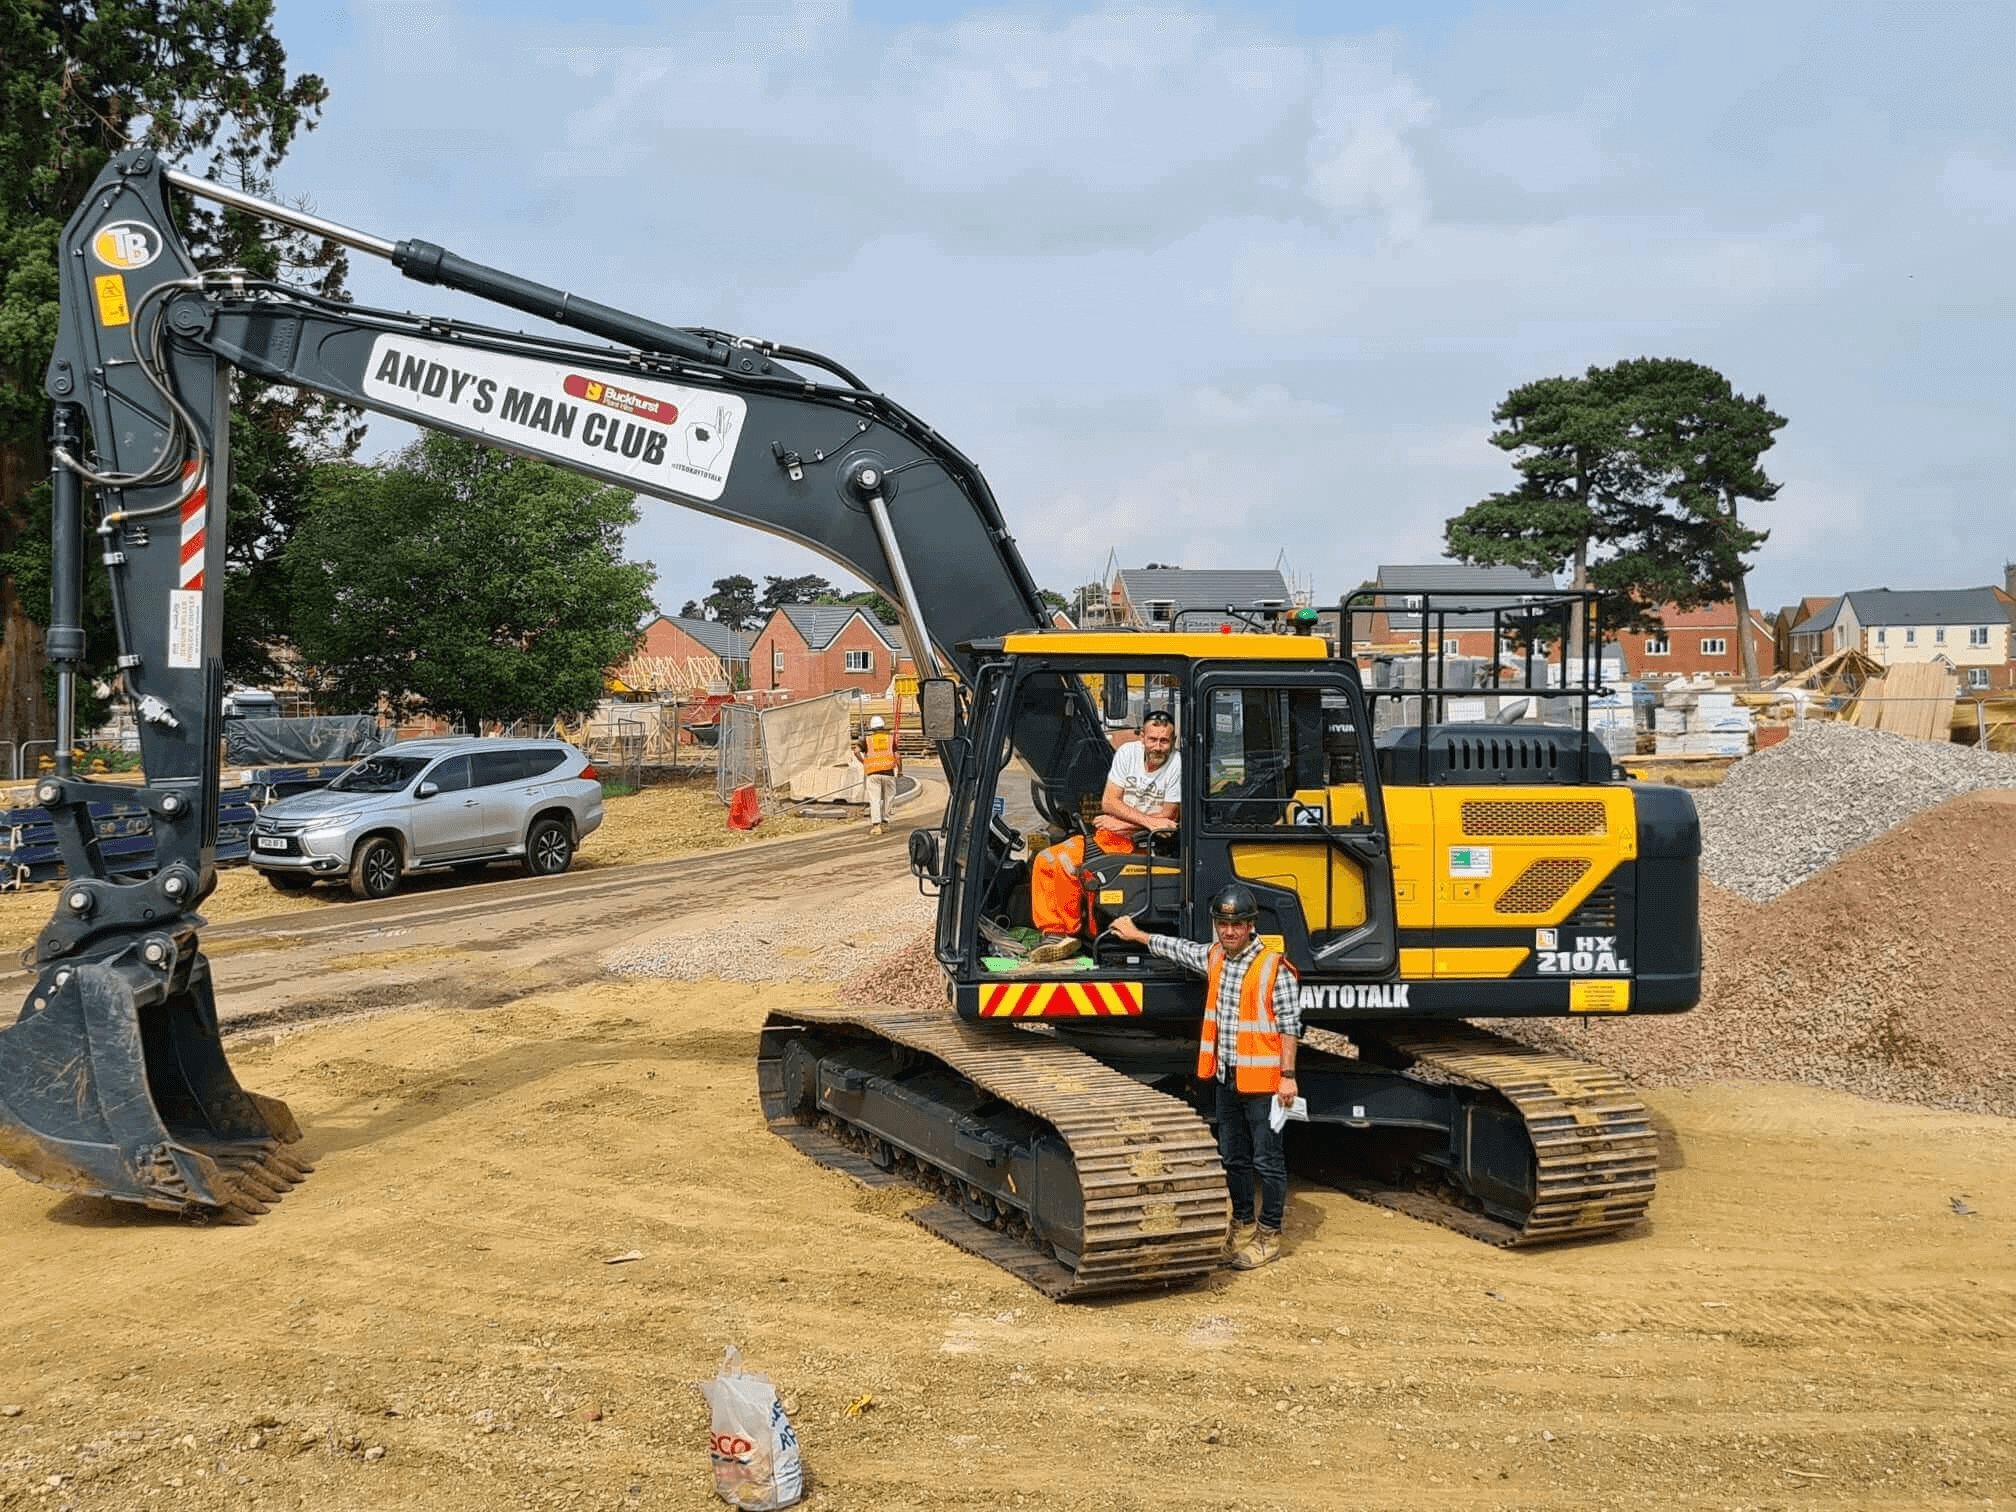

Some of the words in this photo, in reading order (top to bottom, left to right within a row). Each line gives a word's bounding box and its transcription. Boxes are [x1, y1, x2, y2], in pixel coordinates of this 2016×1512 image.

[106, 227, 149, 264] TB
[375, 349, 498, 414] ANDY'S
[499, 386, 579, 439] MAN
[582, 413, 668, 465] CLUB
[603, 387, 660, 414] Buckhurst
[1576, 935, 1617, 952] HX
[1299, 984, 1410, 1009] AYTOTALK
